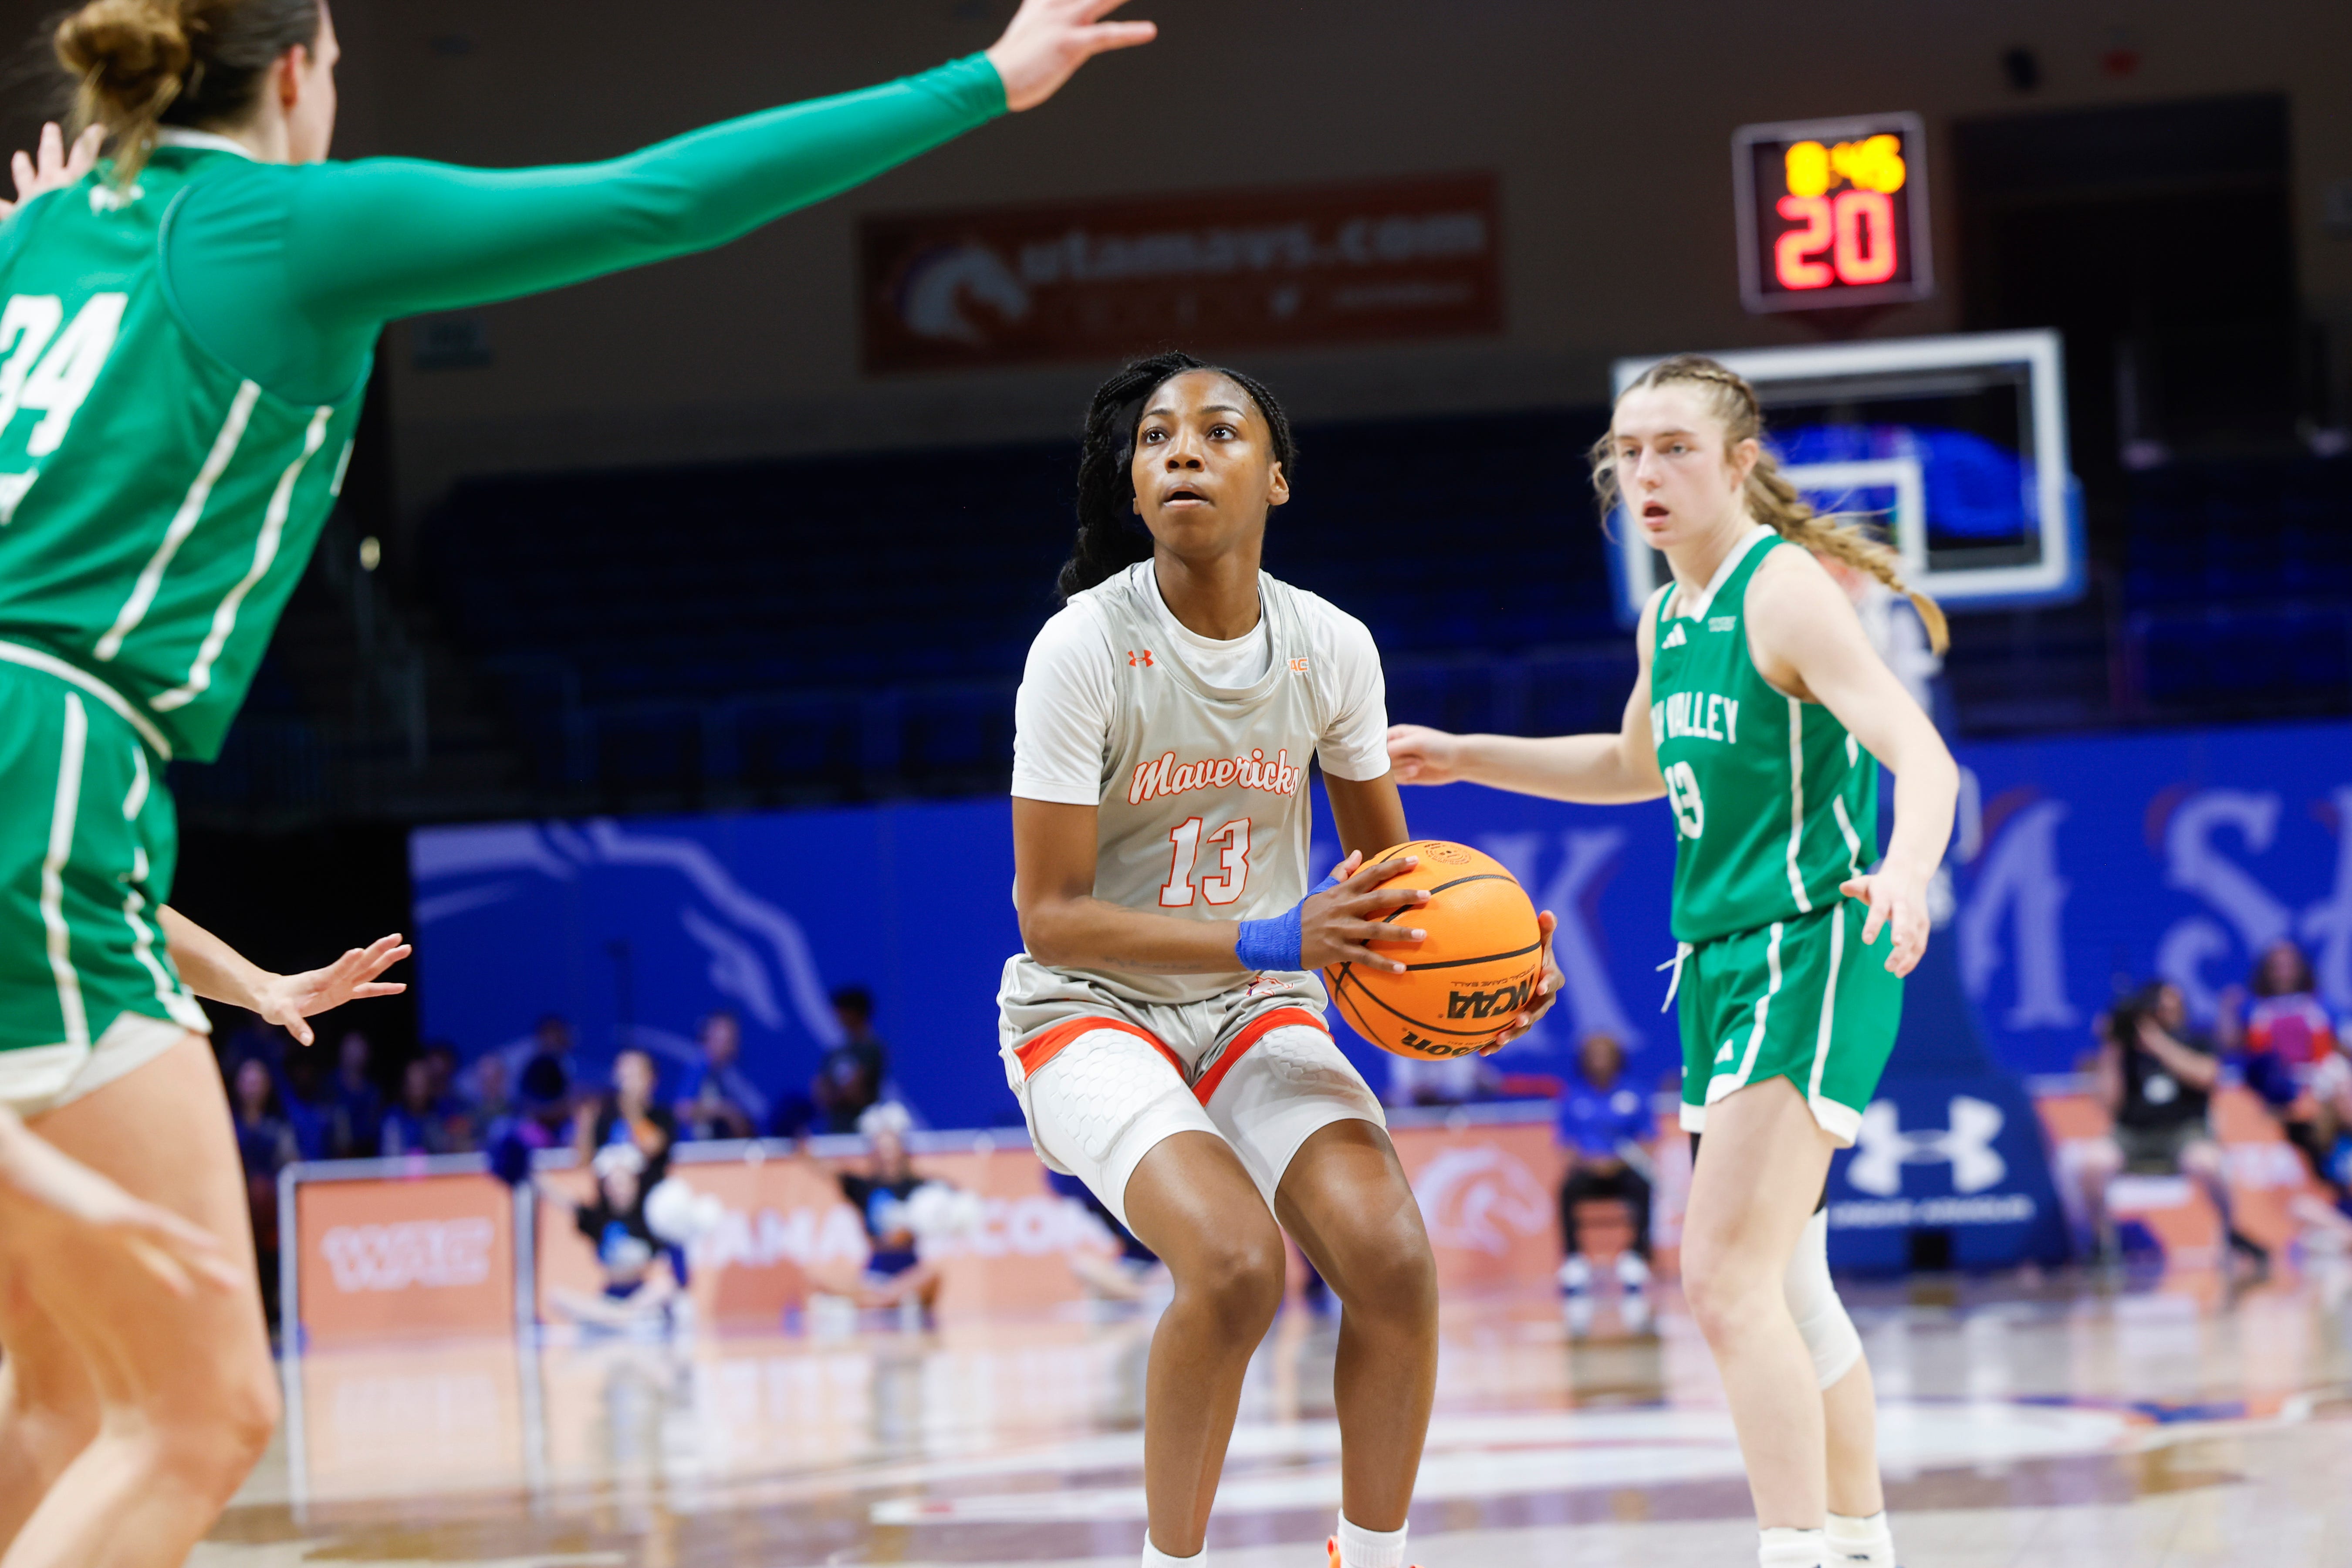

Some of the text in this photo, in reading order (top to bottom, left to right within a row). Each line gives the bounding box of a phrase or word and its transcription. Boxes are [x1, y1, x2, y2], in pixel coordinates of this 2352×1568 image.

[1775, 189, 1897, 291] 20
[1287, 657, 1308, 673] AC
[1128, 748, 1300, 805] Mavericks
[1159, 816, 1252, 907] 13
[1446, 973, 1534, 1019] NCAA
